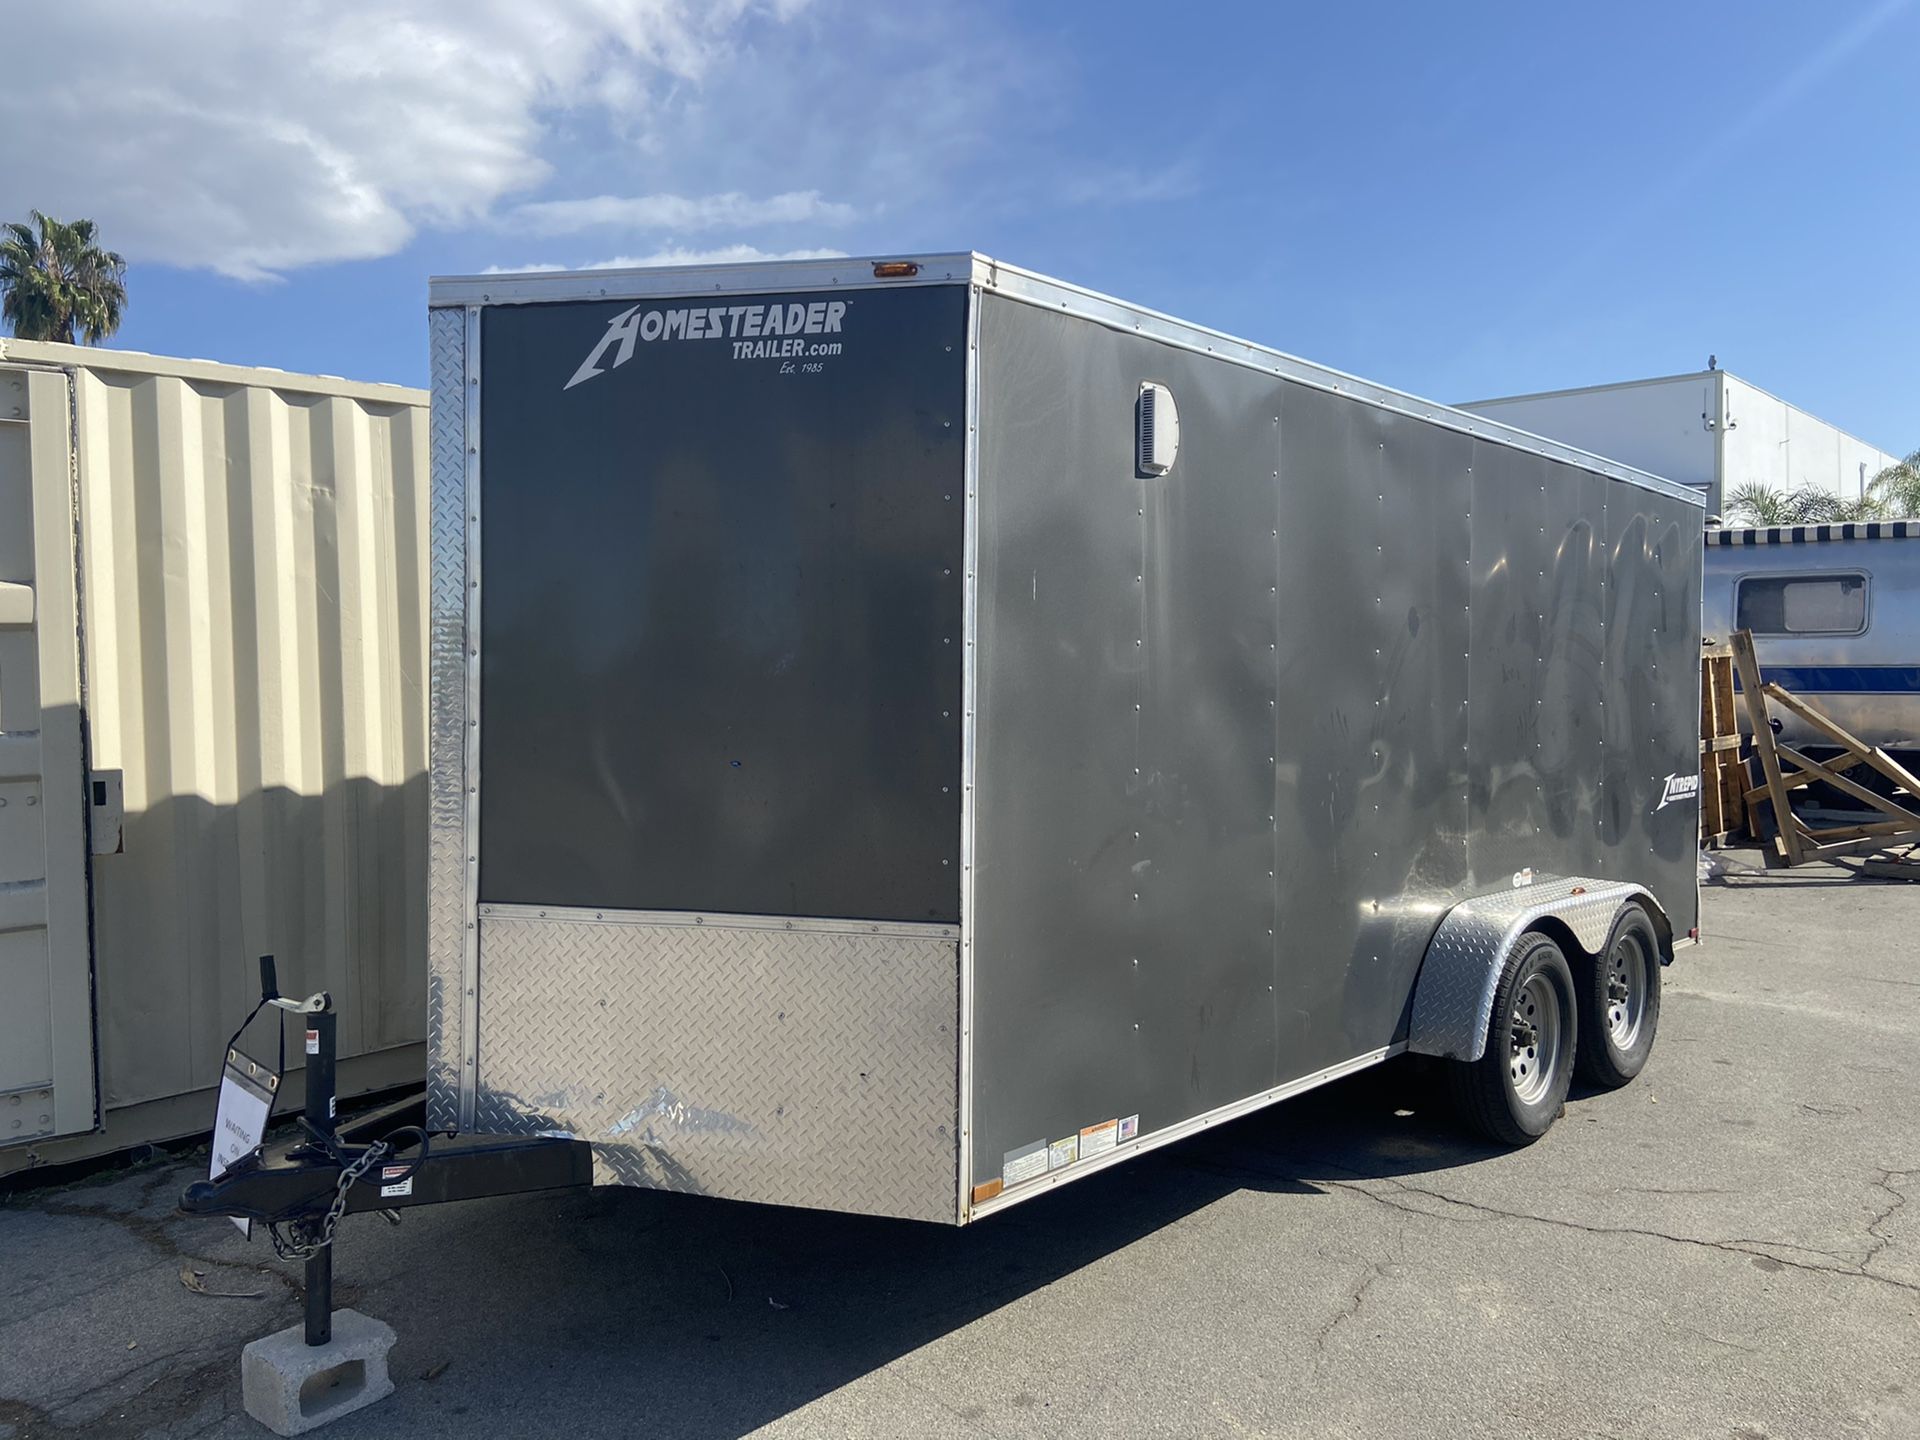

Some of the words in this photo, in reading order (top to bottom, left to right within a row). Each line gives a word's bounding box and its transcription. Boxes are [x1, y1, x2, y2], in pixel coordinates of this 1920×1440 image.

[563, 301, 846, 390] HOMESTEADER
[732, 339, 842, 360] TRAILER.com
[801, 363, 824, 373] 1985
[225, 1117, 251, 1144] WAITING
